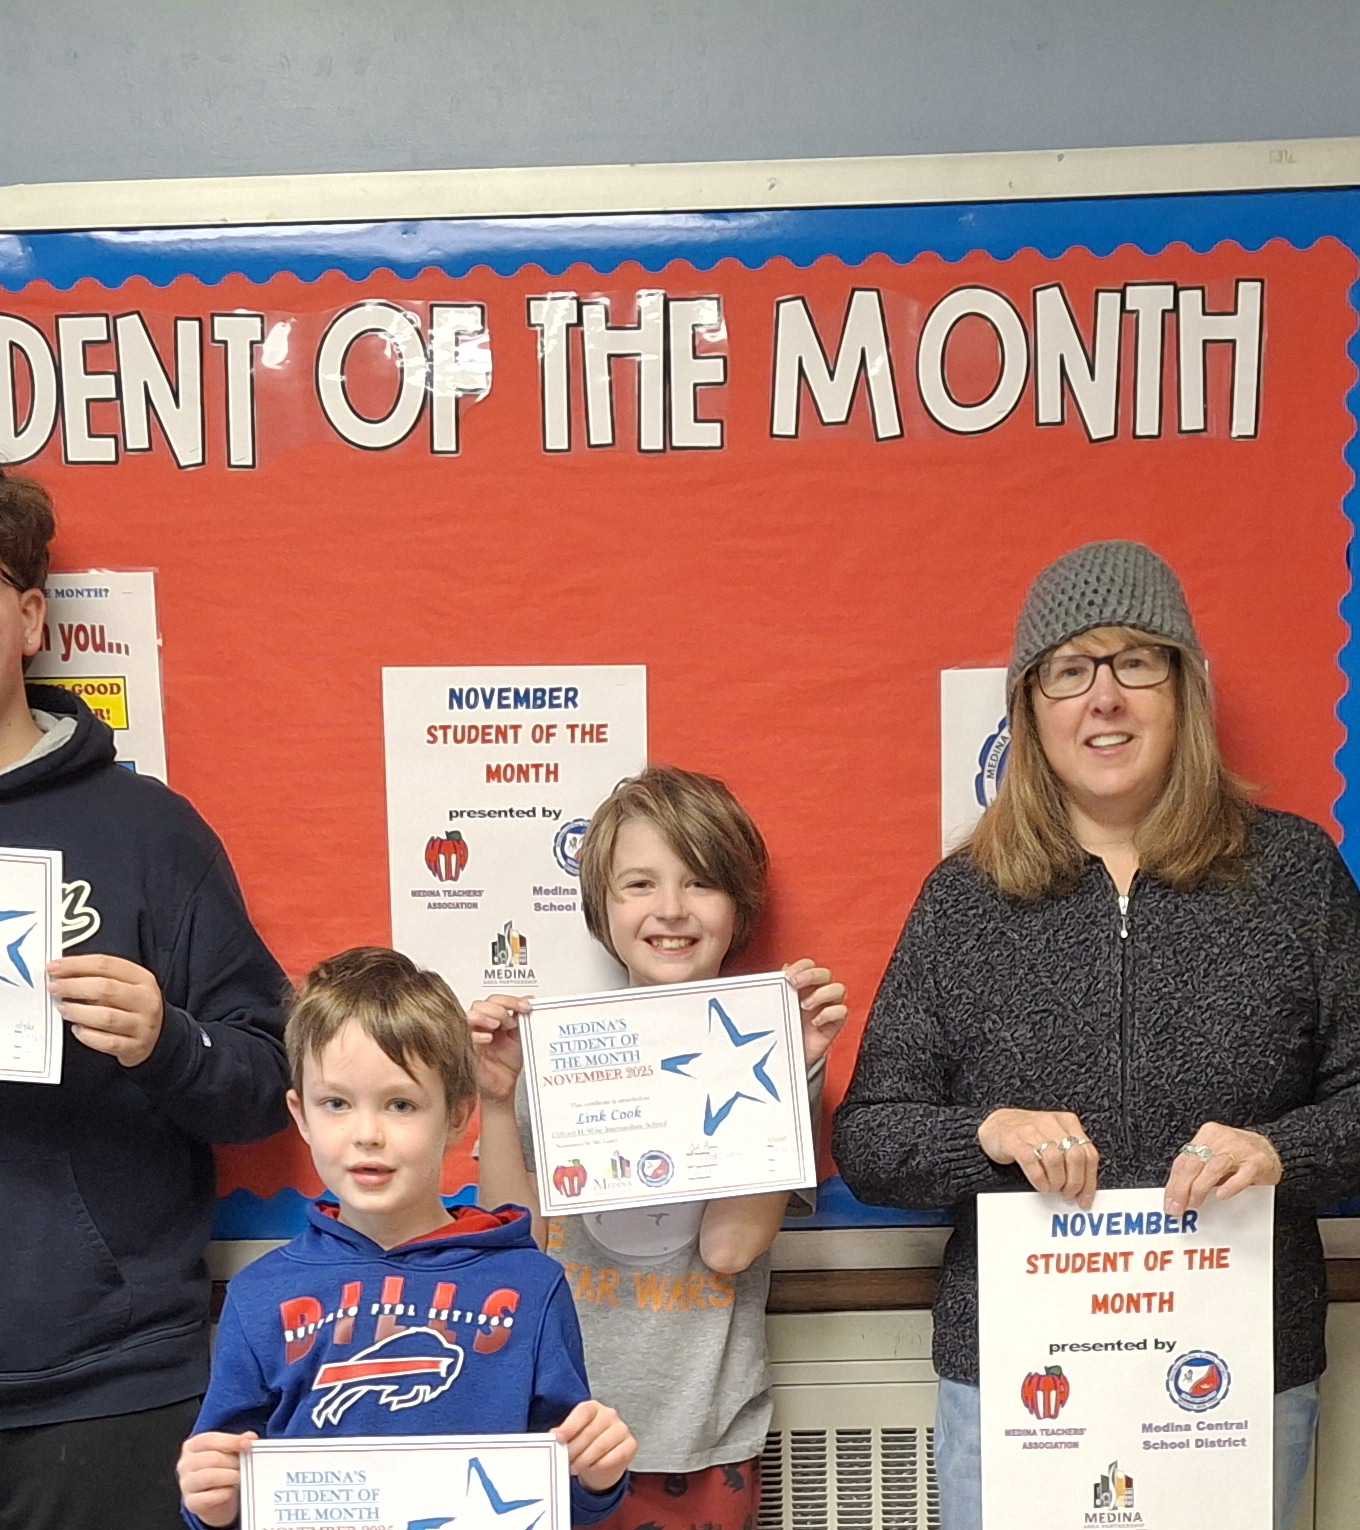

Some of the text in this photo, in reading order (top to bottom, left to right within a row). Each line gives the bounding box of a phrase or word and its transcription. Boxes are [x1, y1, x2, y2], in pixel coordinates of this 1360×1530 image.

[316, 300, 491, 453] OF
[527, 289, 727, 452] THE
[771, 279, 1264, 442] MONTH
[55, 588, 110, 599] MONTH?
[58, 623, 130, 662] you...
[71, 682, 122, 695] GOOD
[448, 687, 579, 710] NOVEMBER
[426, 723, 609, 745] STUDENT OF THE
[987, 735, 1009, 779] MEDINA
[486, 763, 559, 784] MONTH
[448, 807, 562, 821] presented by
[532, 886, 578, 896] Medina
[534, 902, 576, 912] School
[484, 969, 536, 979] MEDINA
[559, 1019, 627, 1035] MEDINA'S
[549, 1034, 640, 1053] STUDENT OF
[551, 1050, 640, 1070] THE MONTH
[543, 1065, 654, 1087] NOVEMBER 2025
[576, 1105, 642, 1124] Link Cook
[1051, 1209, 1199, 1238] NOVEMBER
[1025, 1247, 1231, 1274] STUDENT OF THE
[1091, 1292, 1175, 1314] MONTH
[1048, 1337, 1177, 1355] presented by
[1141, 1420, 1249, 1433] Medina Central
[1142, 1437, 1247, 1450] School District
[286, 1470, 367, 1484] MEDINA'S
[274, 1488, 380, 1503] STUDENT OF
[275, 1507, 380, 1521] THE MONTH
[1084, 1511, 1143, 1523] MEDINA
